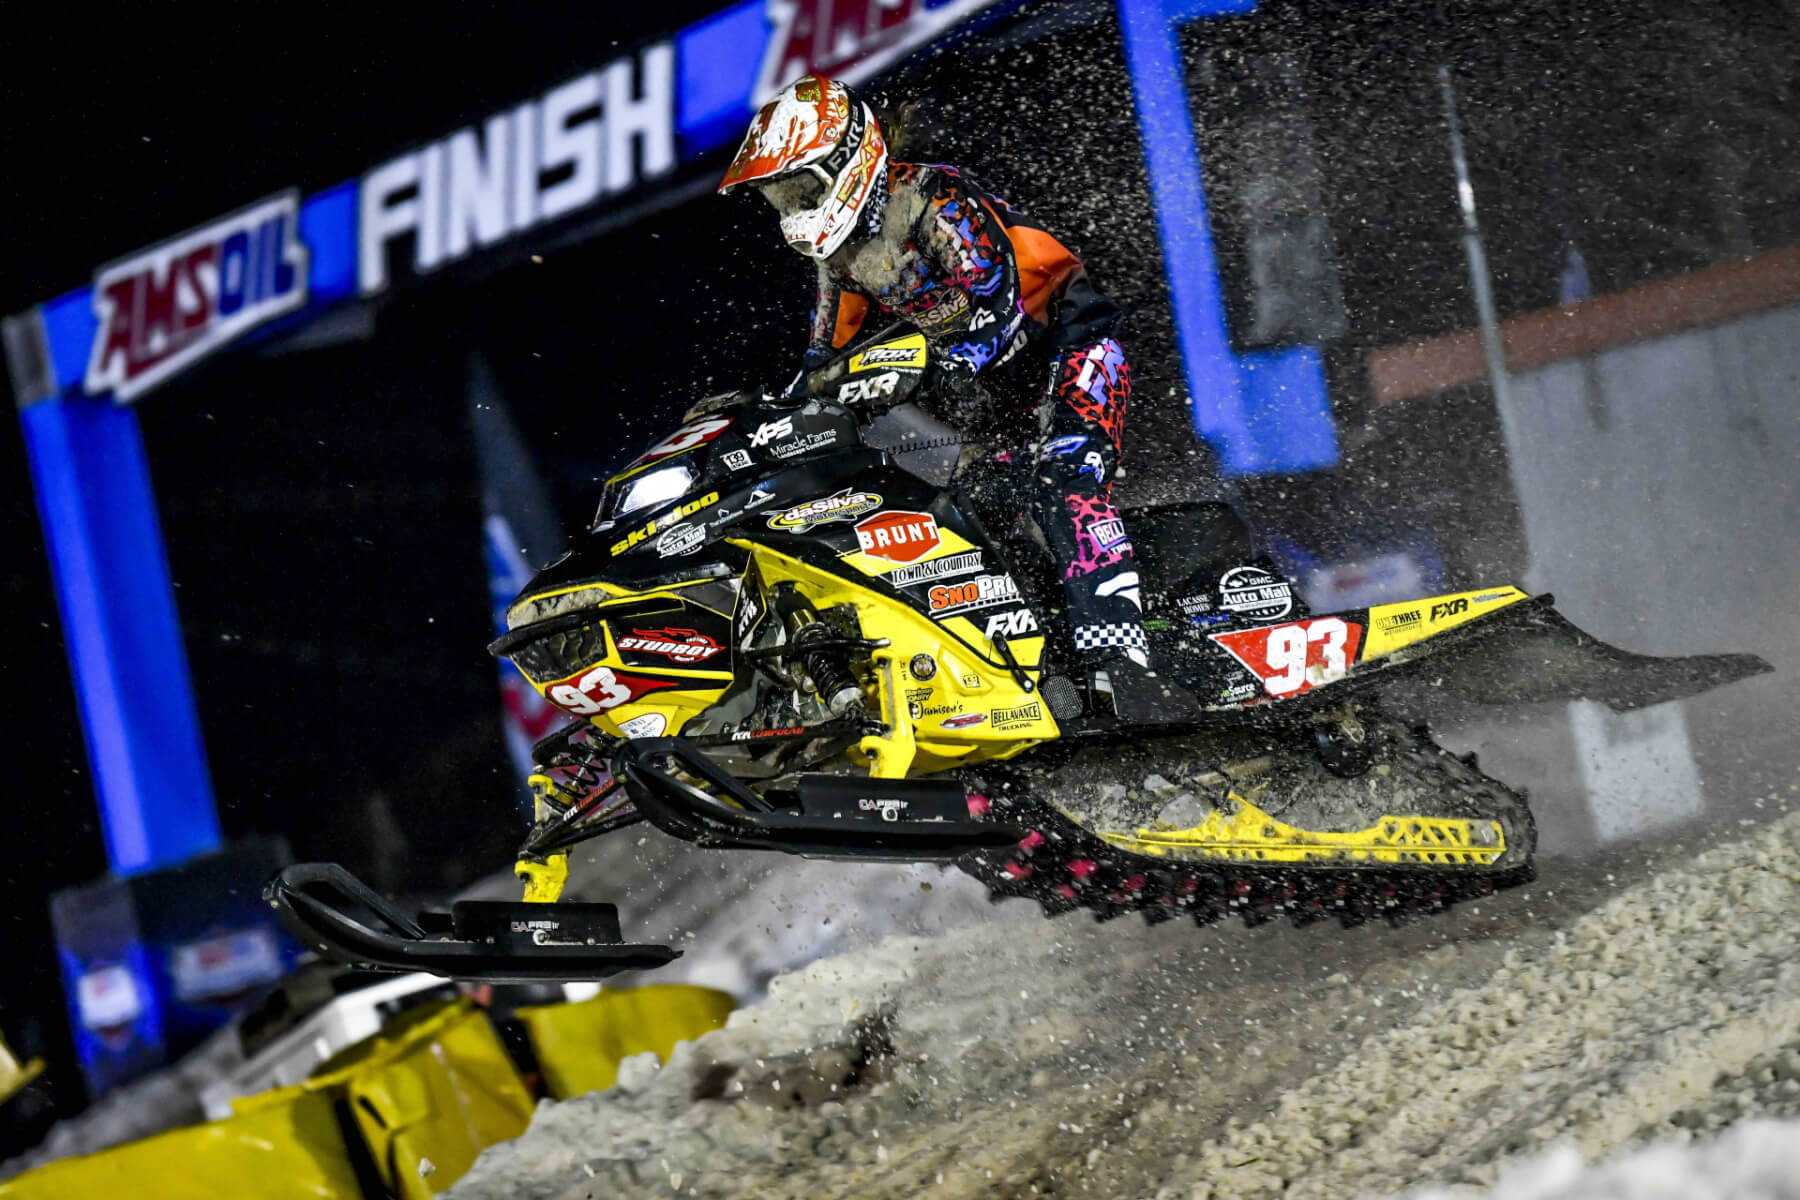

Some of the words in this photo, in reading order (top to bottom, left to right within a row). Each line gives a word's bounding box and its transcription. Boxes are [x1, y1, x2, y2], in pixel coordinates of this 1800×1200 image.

[828, 121, 863, 171] FXR
[360, 43, 676, 293] FINISH
[100, 211, 295, 380] AMSOIL
[837, 371, 900, 404] FXR
[746, 415, 793, 448] XPS
[769, 435, 807, 457] Miracle
[807, 428, 837, 444] Farms
[784, 494, 867, 521] daSilva
[685, 523, 706, 542] Mall
[859, 522, 937, 550] BRUNT
[892, 563, 924, 584] TOWN
[924, 561, 935, 574] &
[936, 552, 982, 573] COUNTRY
[1249, 576, 1273, 585] GMC
[1176, 594, 1209, 606] LACASSE
[1184, 603, 1210, 614] HOMES
[1223, 591, 1259, 606] Auto
[1260, 585, 1292, 600] Mall
[1430, 598, 1469, 622] FXR
[617, 638, 719, 657] STUDBOY
[1264, 617, 1348, 695] 93
[551, 666, 632, 714] 93
[994, 705, 1038, 724] BELLAVANCE
